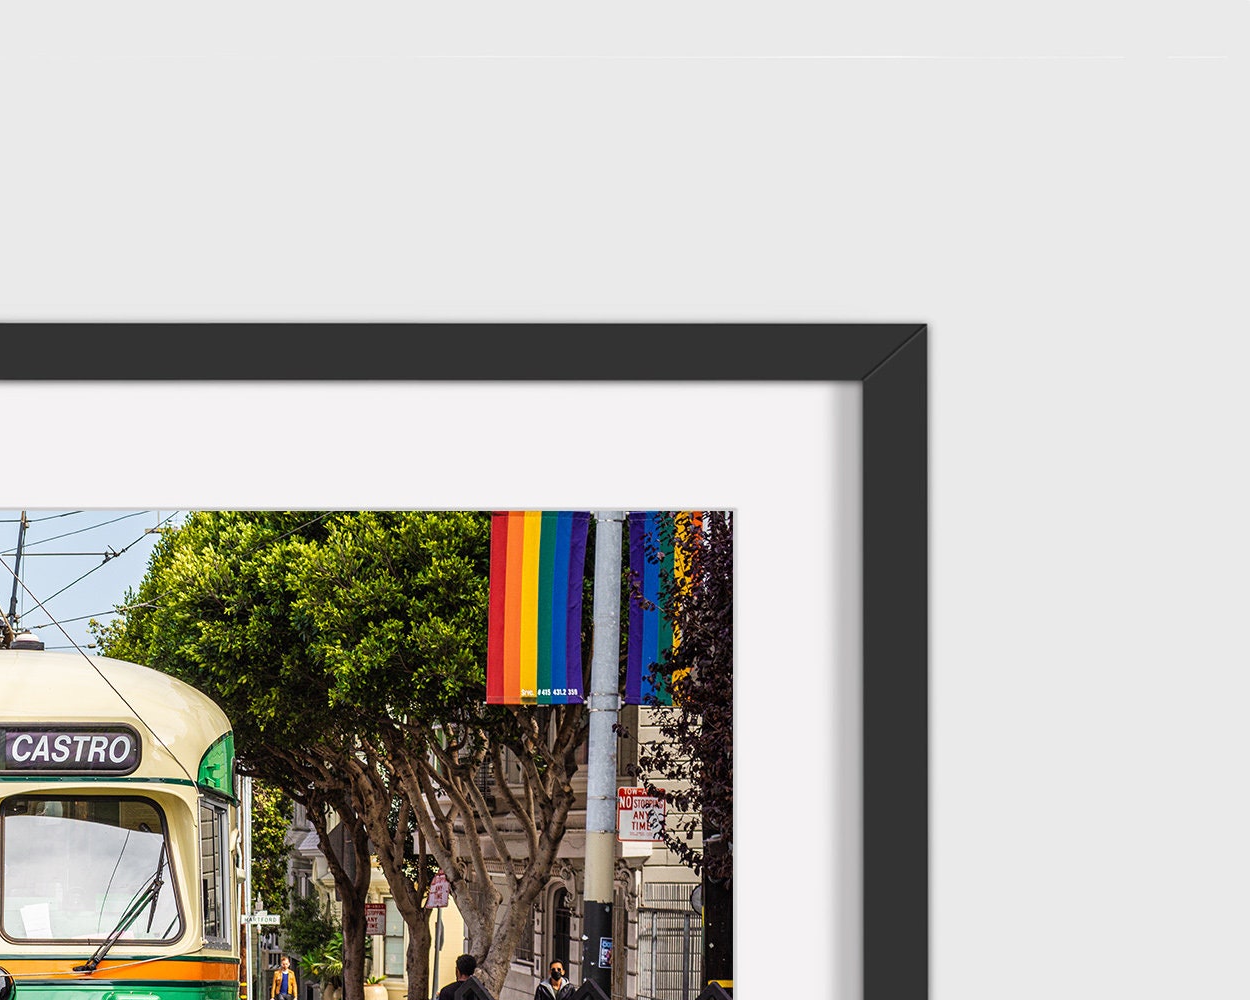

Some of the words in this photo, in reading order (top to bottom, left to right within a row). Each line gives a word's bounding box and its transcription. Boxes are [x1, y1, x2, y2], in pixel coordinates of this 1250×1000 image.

[11, 734, 132, 764] CASTRO
[620, 796, 632, 808] NO
[633, 811, 649, 820] ANY
[631, 821, 651, 830] TIME
